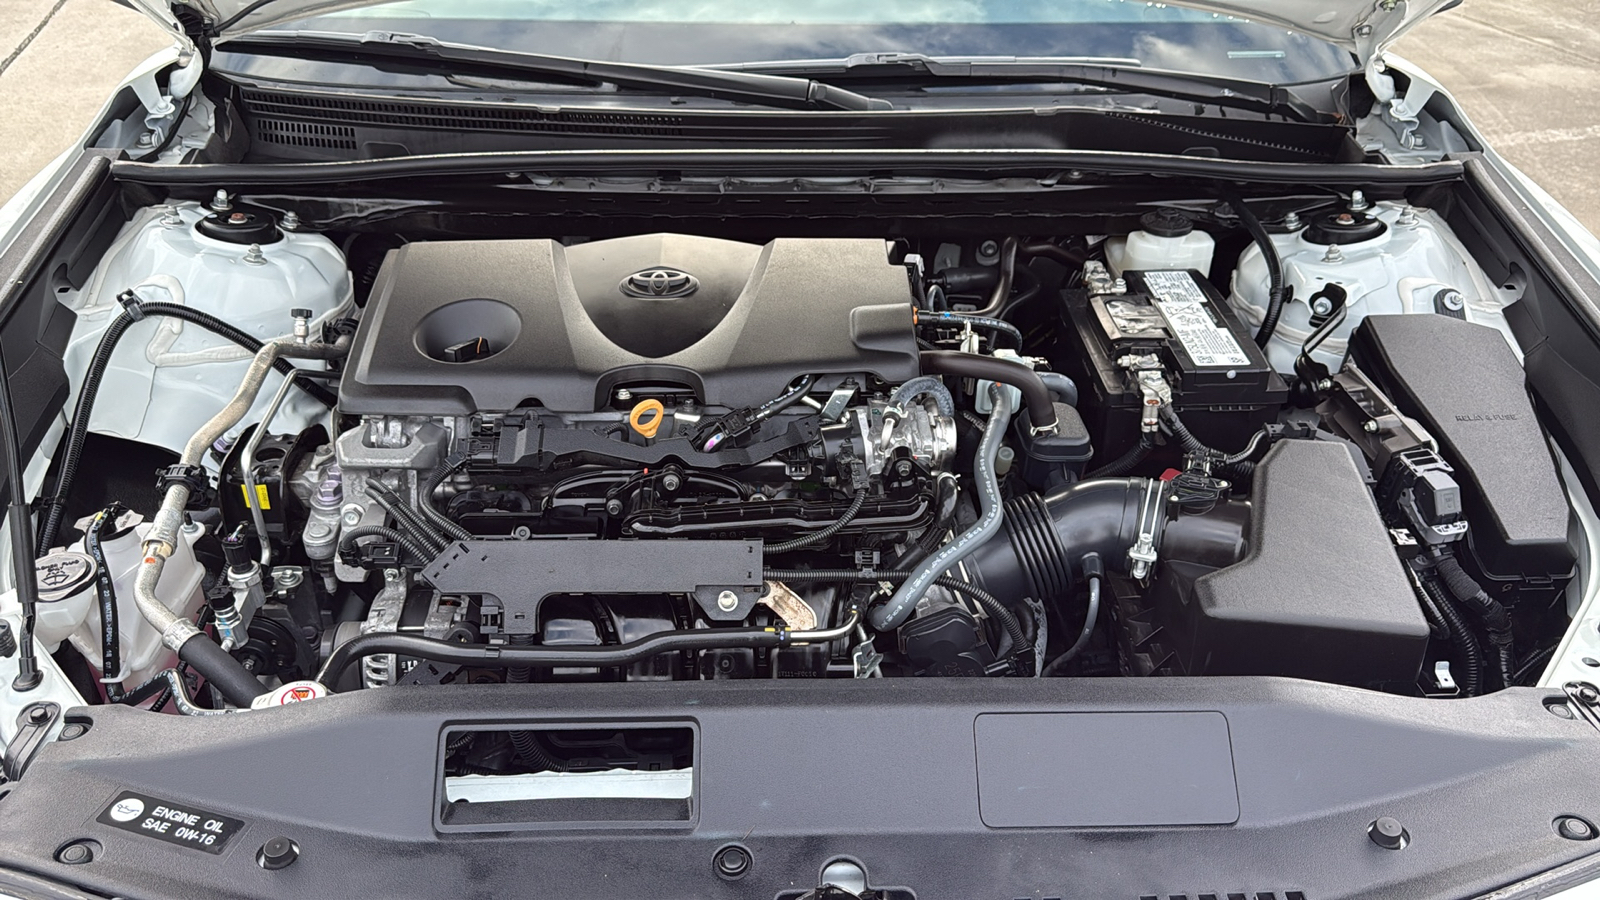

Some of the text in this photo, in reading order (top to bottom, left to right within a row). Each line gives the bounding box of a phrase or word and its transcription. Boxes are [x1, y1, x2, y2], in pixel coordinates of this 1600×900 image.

[142, 818, 216, 845] SAE 0W-16
[152, 806, 223, 833] ENGINE OIL
